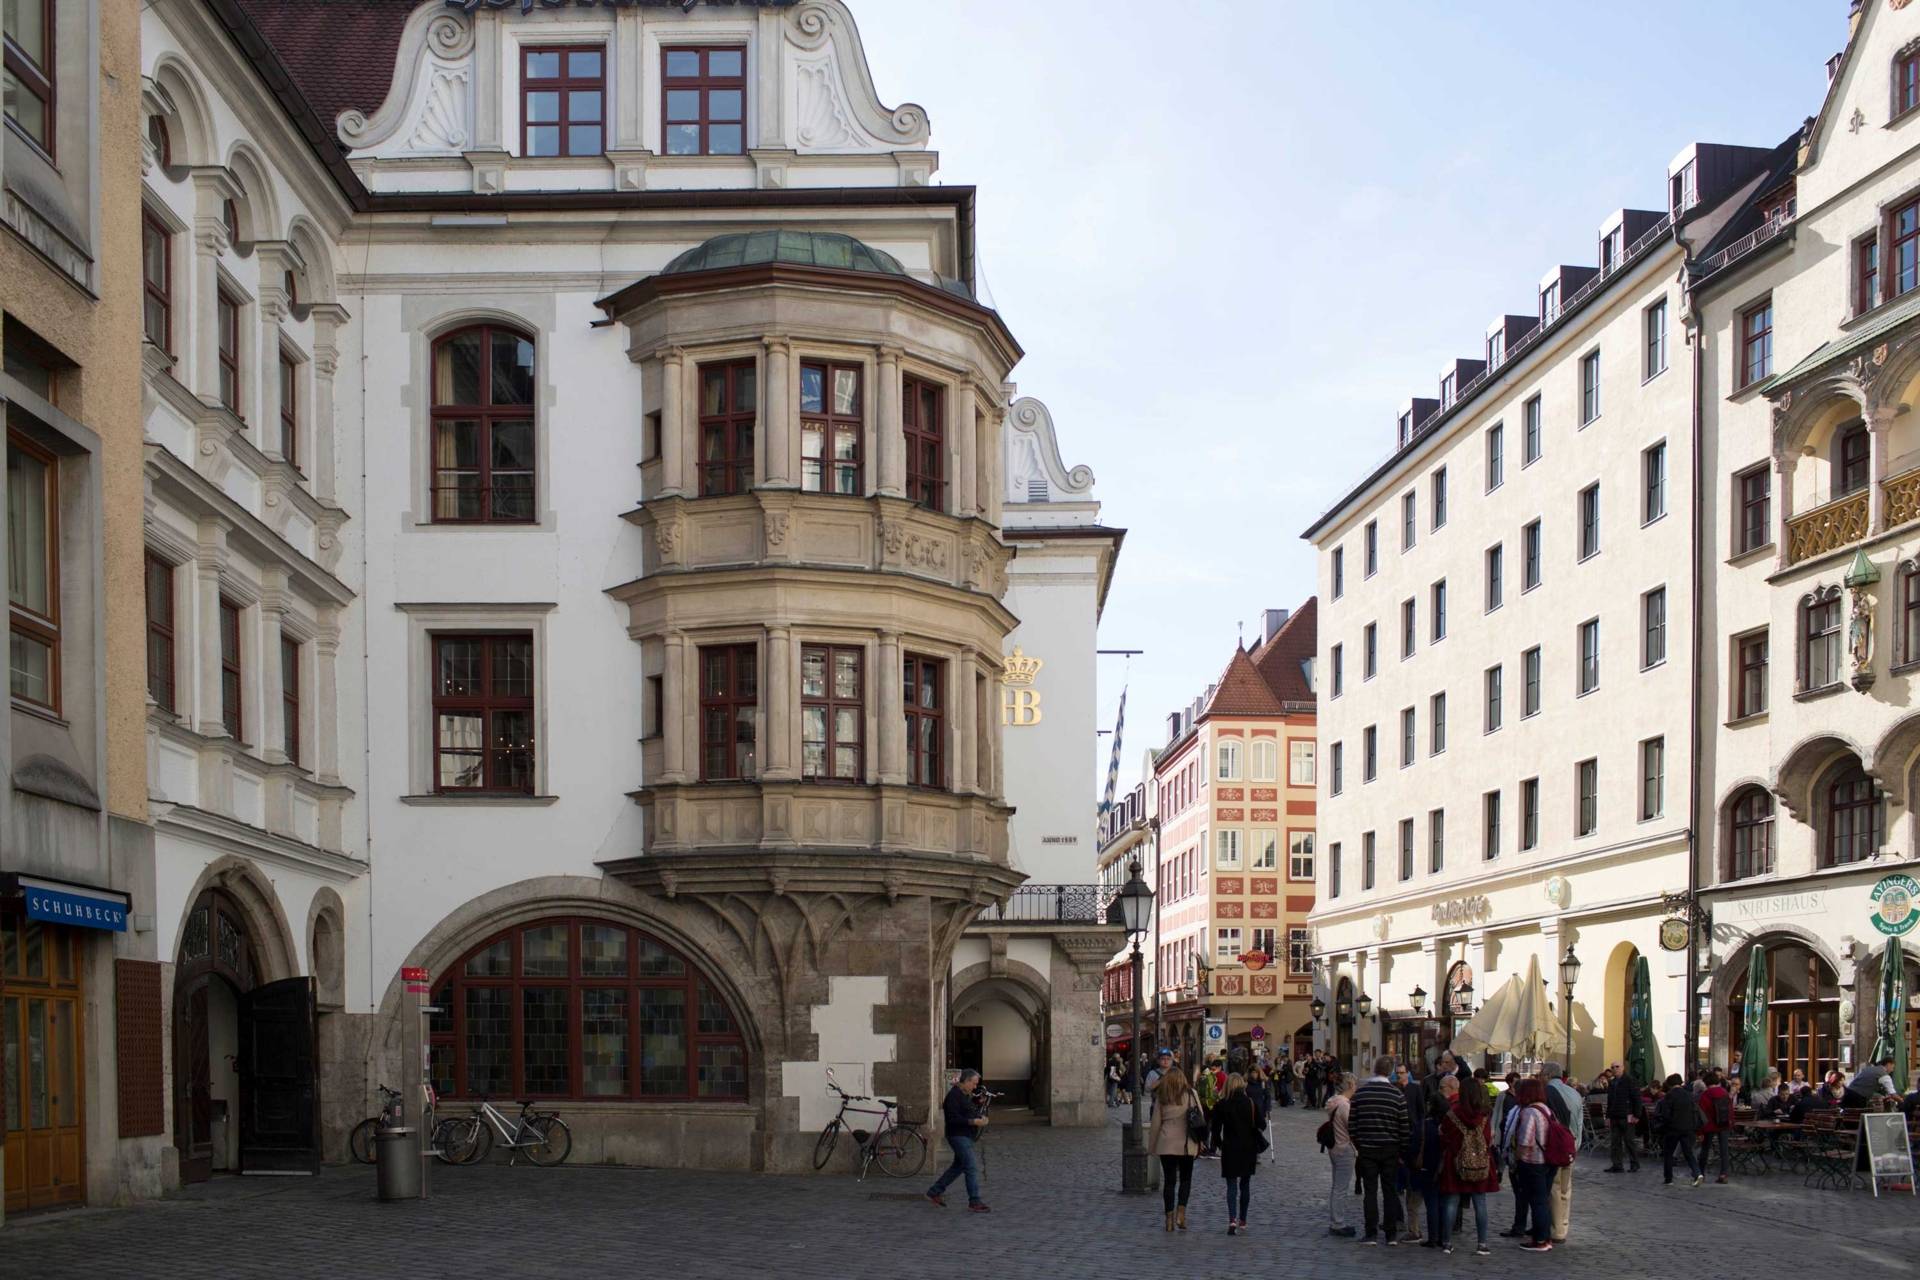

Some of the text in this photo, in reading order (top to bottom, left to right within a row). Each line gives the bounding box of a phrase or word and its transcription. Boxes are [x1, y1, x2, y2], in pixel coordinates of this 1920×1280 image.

[1001, 688, 1042, 726] HB
[1873, 876, 1918, 900] AYINGERS
[1738, 892, 1819, 915] WIRTSHAUS
